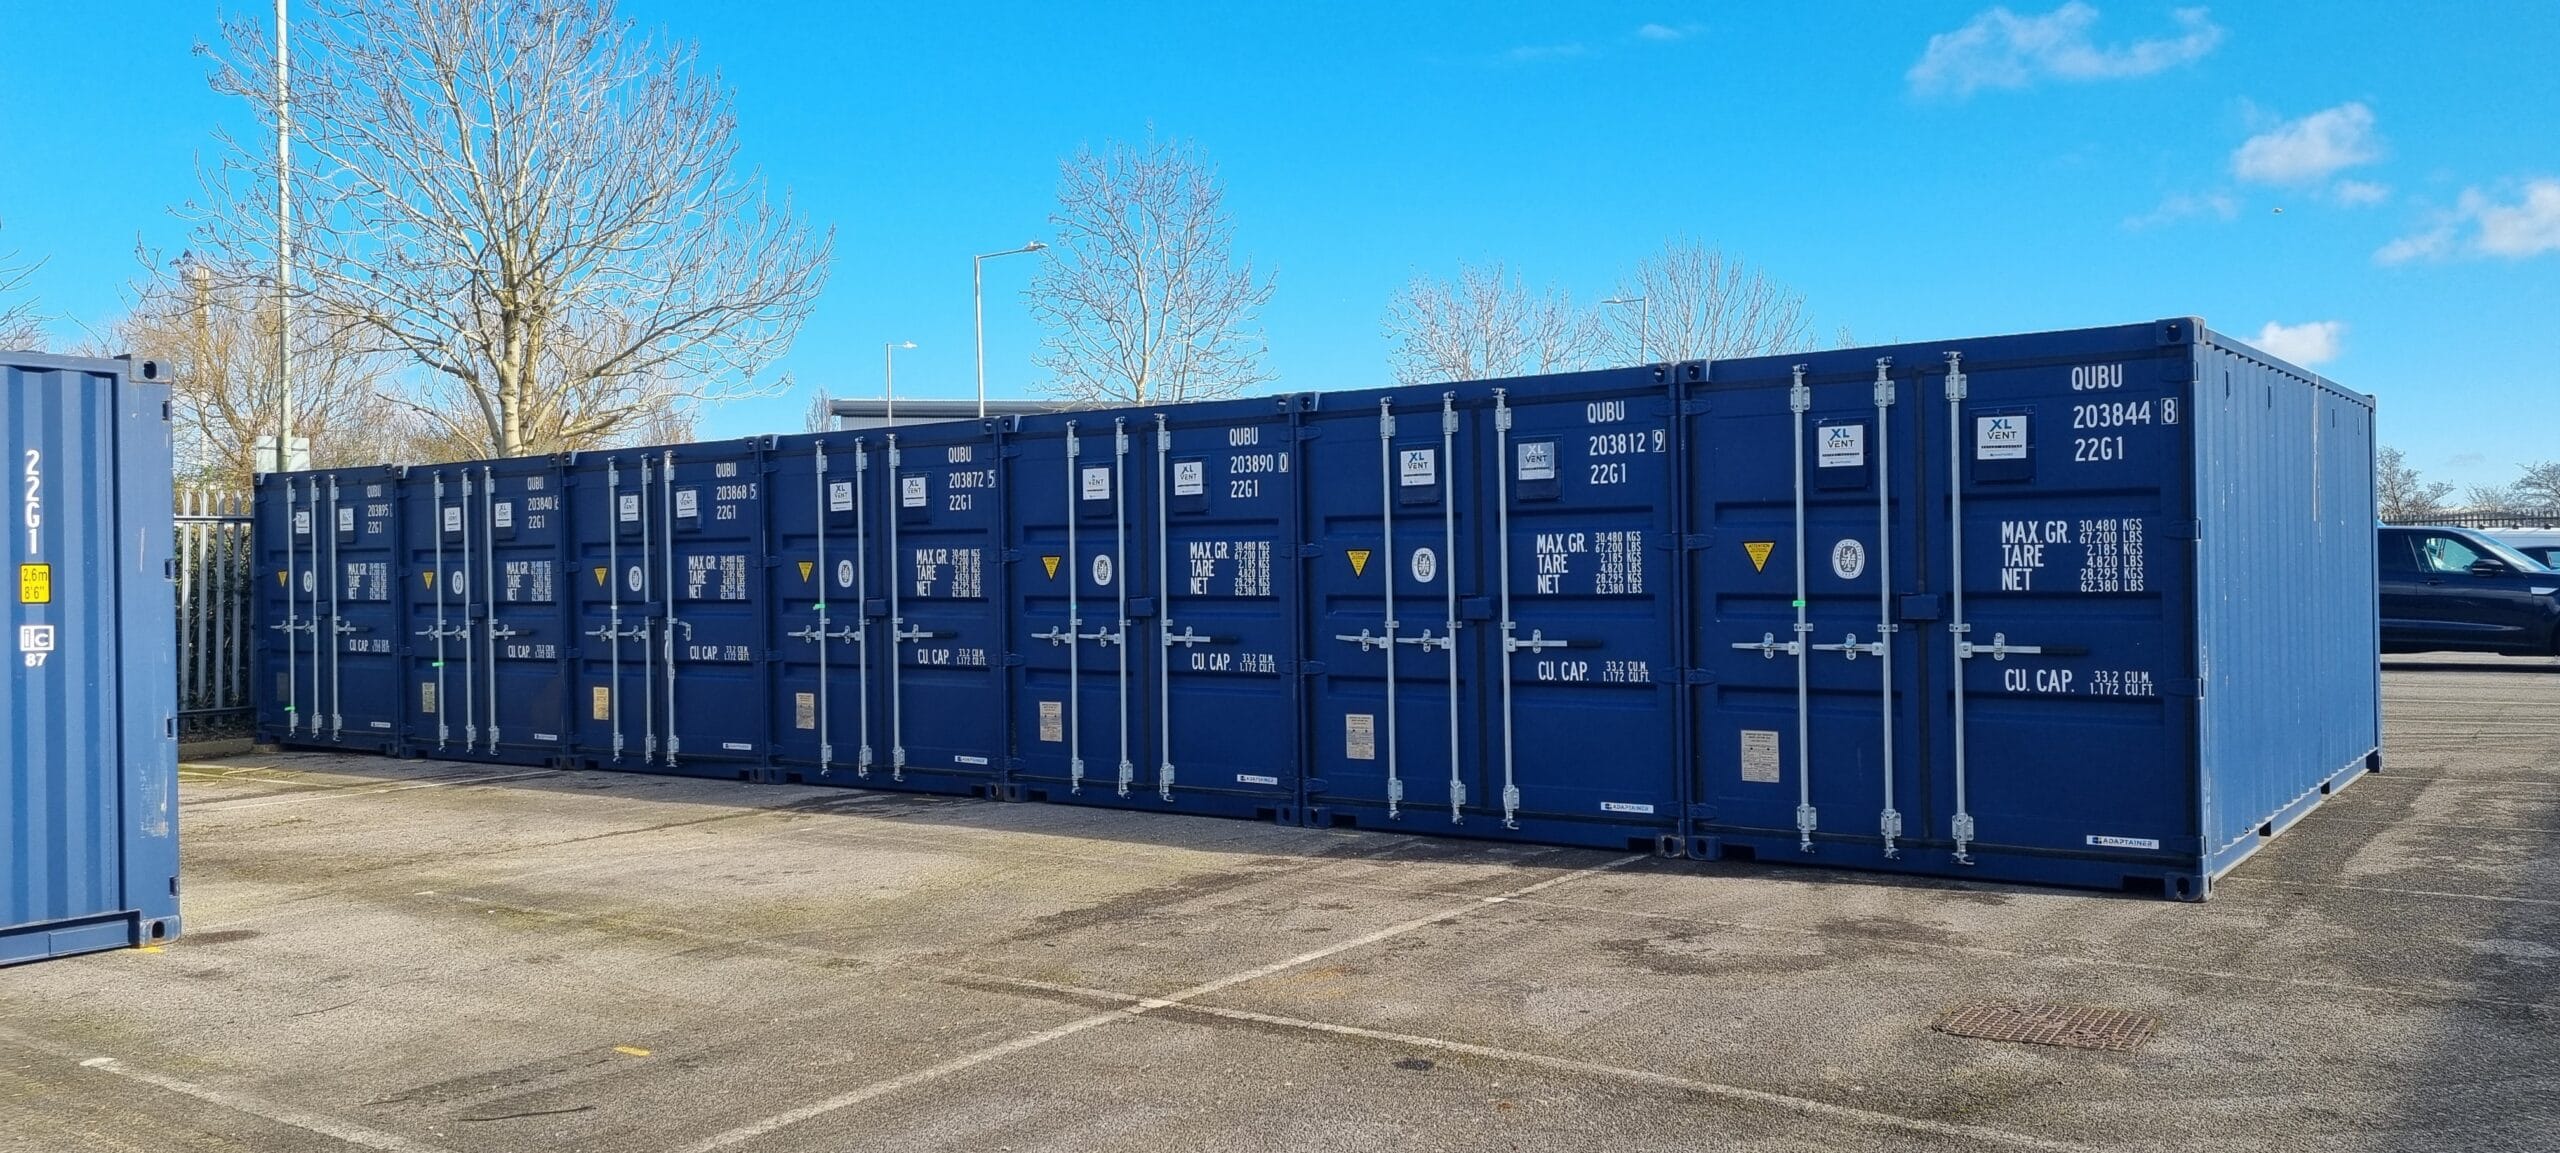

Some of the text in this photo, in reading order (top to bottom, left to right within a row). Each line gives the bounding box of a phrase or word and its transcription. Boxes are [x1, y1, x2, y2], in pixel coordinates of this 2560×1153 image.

[2071, 364, 2123, 391] QUBU
[1587, 400, 1625, 424] QUBU
[2073, 398, 2177, 429] 203844 8
[1989, 419, 2012, 432] XL
[1230, 427, 1258, 446] QUBU
[1830, 428, 1850, 441] XL
[1987, 431, 2017, 440] VENT
[1526, 444, 1544, 456] XL
[1589, 430, 1665, 456] 203812 9
[1827, 439, 1855, 448] VENT
[2075, 436, 2123, 462] 22G1
[949, 446, 972, 464] QUBU
[1409, 452, 1425, 463] XL
[1526, 455, 1548, 463] VENT
[716, 462, 737, 478] QUBU
[1182, 464, 1194, 475] XL
[1231, 454, 1273, 474] 203890
[949, 470, 996, 488] 203872 5
[1180, 473, 1197, 481] VENT
[1590, 463, 1626, 485] 22G1
[835, 485, 846, 493] XL
[908, 480, 919, 488] XL
[1231, 480, 1258, 498] 22G1
[716, 485, 747, 500] 203868
[26, 449, 40, 554] 22G1
[950, 494, 972, 511] 22G1
[717, 505, 736, 520] 22G1
[2079, 518, 2143, 532] 30.480 KGS
[1626, 531, 1642, 541] KGS
[2079, 531, 2143, 544] 67.200 LBS
[1626, 542, 1642, 552] LBS
[2087, 543, 2143, 556] 2.185 KGS
[1626, 553, 1642, 562] KGS
[2002, 544, 2044, 567] TARE
[2087, 555, 2143, 568] 4.820 LBS
[1190, 559, 1215, 577] TARE
[1537, 554, 1569, 573] TARE
[1626, 562, 1642, 573] LBS
[689, 570, 707, 585] TARE
[917, 565, 936, 580] TARE
[1626, 573, 1642, 583] KGS
[2002, 568, 2033, 591] NET
[2079, 567, 2143, 580] 28.295 KGS
[917, 581, 931, 597] NET
[1191, 577, 1208, 595] NET
[1537, 574, 1560, 594] NET
[1626, 584, 1642, 594] LBS
[2079, 580, 2143, 592] 62.380 LBS
[689, 585, 702, 599] NET
[25, 653, 47, 667] 87
[932, 649, 950, 665] CAP.
[1192, 652, 1232, 671] CU. CAP.
[1538, 661, 1589, 681] CU. CAP.
[1606, 661, 1624, 672] 33.2
[2005, 668, 2075, 693] CU. CAP.
[2094, 670, 2119, 683] 33.2
